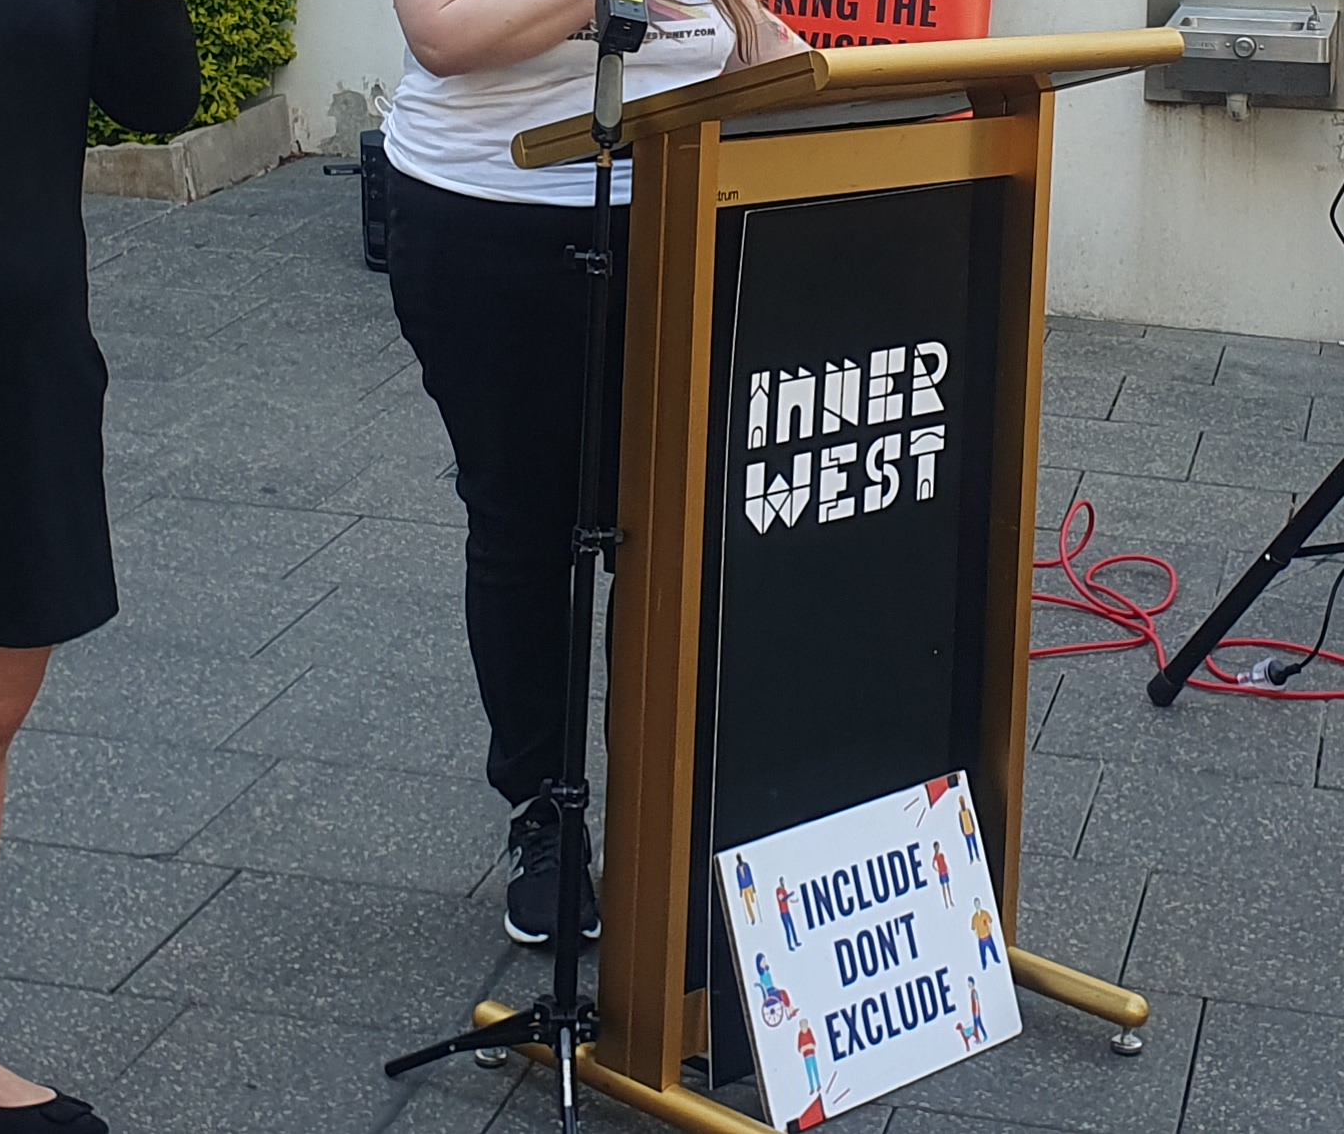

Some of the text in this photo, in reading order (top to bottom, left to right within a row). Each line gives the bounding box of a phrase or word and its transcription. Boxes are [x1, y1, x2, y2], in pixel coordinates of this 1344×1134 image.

[716, 190, 739, 202] trum
[747, 341, 948, 450] INNER
[745, 424, 945, 535] WEST
[799, 842, 928, 930] INCLUDE
[834, 912, 919, 988] DON'T
[825, 966, 956, 1062] EXCLUDE
